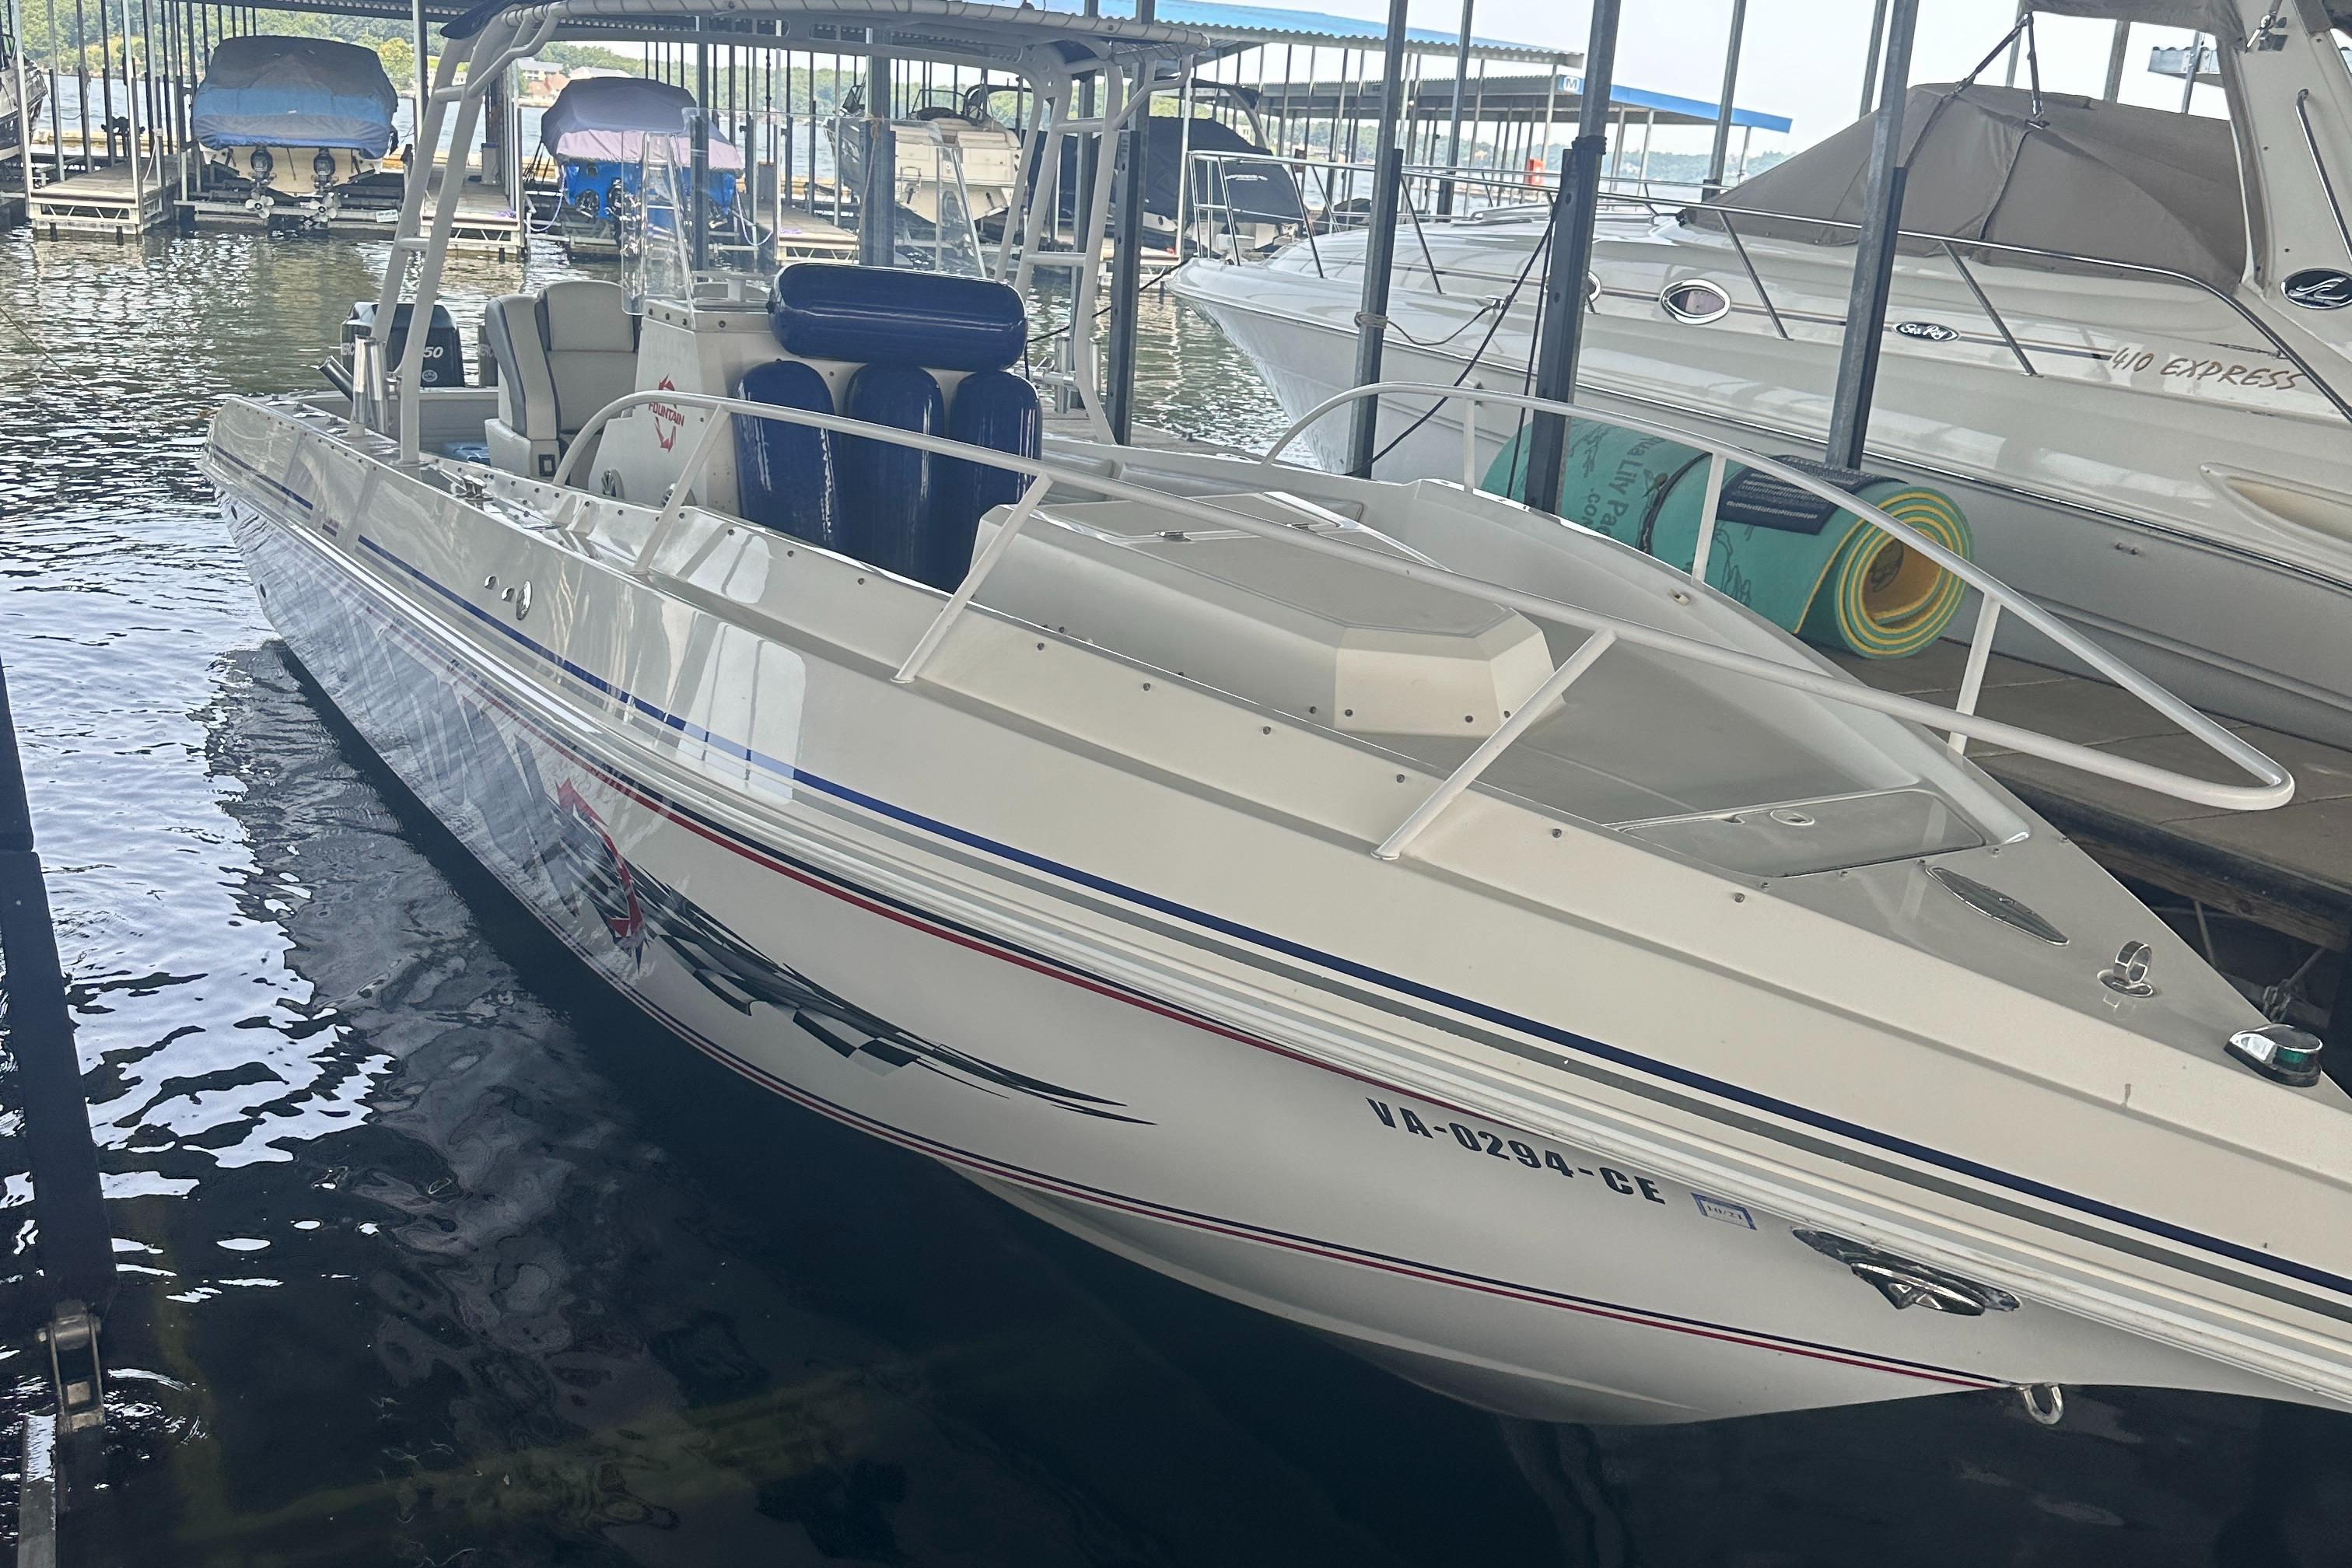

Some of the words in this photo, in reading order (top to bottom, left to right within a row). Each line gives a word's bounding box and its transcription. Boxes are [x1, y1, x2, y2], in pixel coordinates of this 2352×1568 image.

[1566, 78, 1577, 89] M
[422, 346, 444, 359] 50
[2112, 347, 2154, 372] 410
[2160, 358, 2305, 390] EXPRESS
[648, 401, 685, 427] FOUNTAIN
[1608, 459, 1643, 495] Lily
[1366, 1097, 1666, 1204] VA-0294-CE
